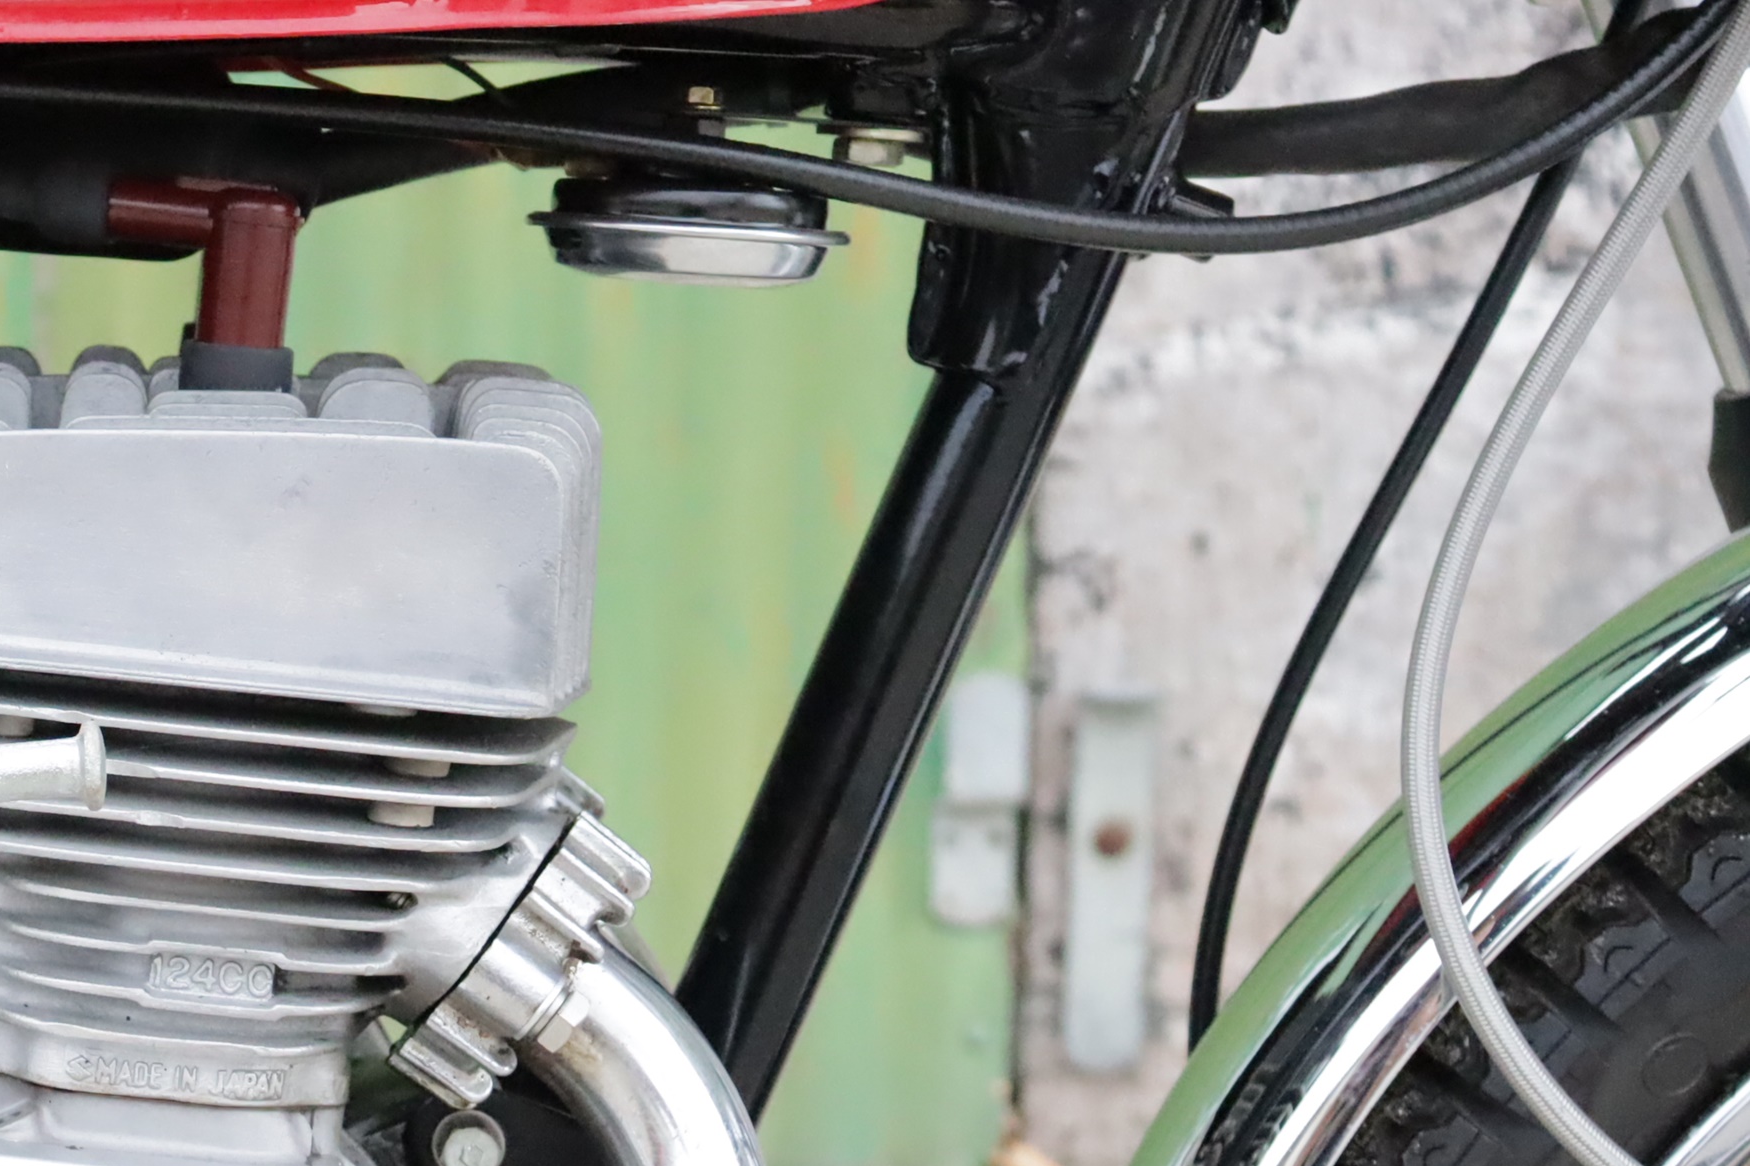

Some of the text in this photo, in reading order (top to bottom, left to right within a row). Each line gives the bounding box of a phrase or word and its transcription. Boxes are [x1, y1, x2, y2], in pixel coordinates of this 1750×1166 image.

[150, 955, 273, 996] 124CC
[93, 1057, 286, 1101] MADE IN JAPAN
